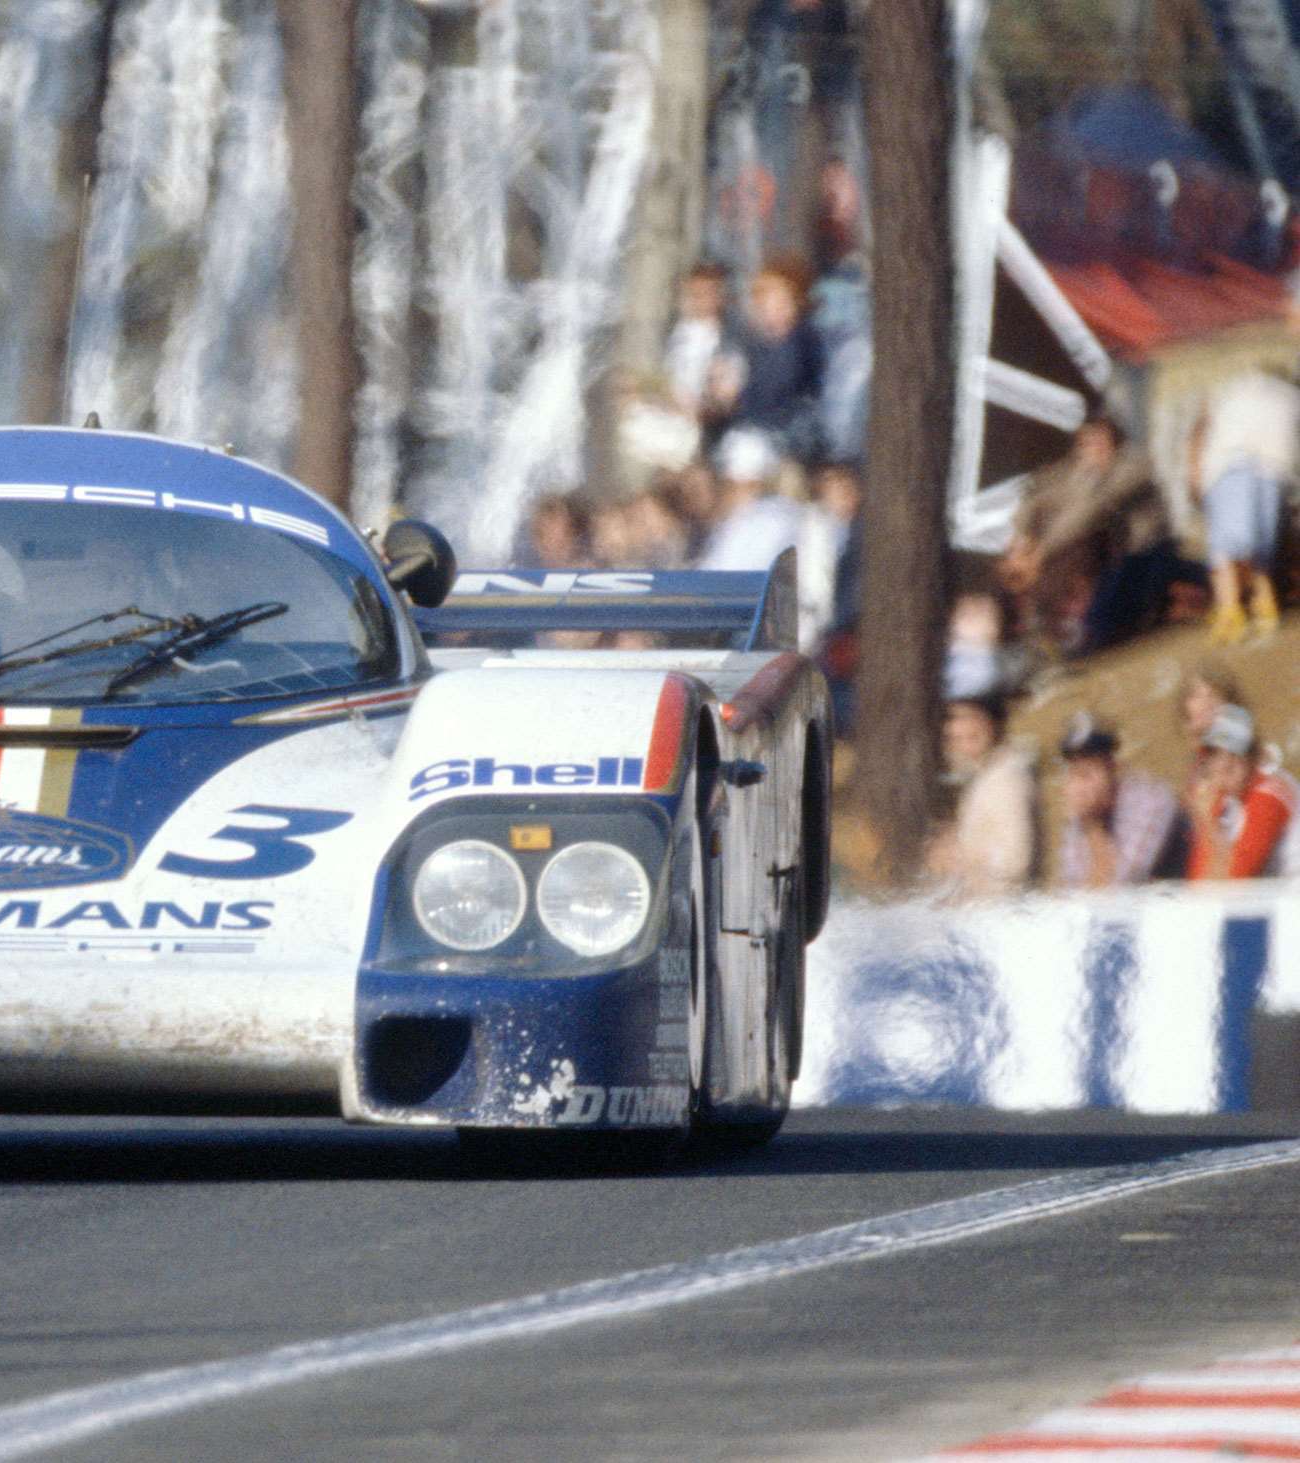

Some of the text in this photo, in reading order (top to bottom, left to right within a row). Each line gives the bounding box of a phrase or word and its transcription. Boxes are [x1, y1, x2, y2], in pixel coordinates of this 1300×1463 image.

[408, 756, 645, 801] Shell
[157, 803, 356, 881] 3
[556, 1085, 688, 1125] DUN
